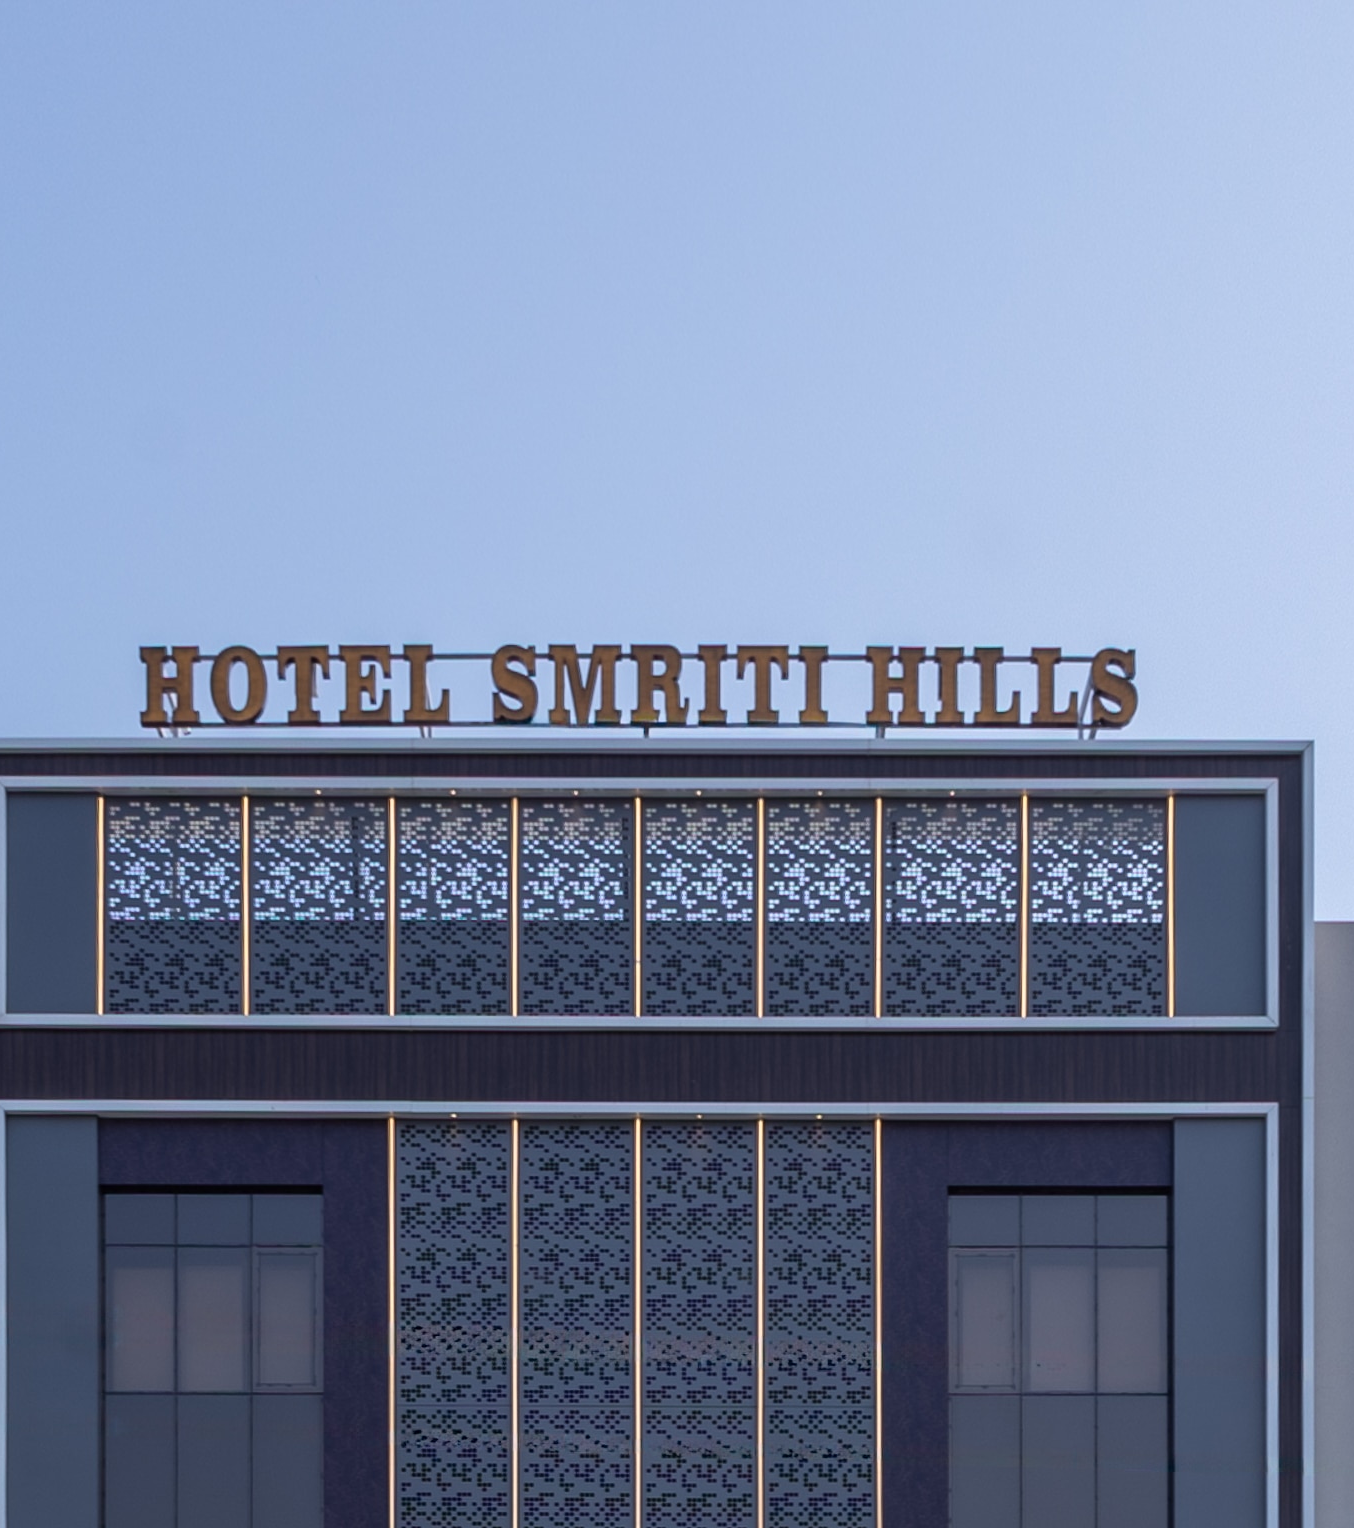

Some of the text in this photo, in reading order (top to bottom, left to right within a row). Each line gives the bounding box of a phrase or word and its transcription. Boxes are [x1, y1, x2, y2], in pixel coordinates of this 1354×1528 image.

[139, 643, 1139, 728] HOTEL SMRITI HILLS
